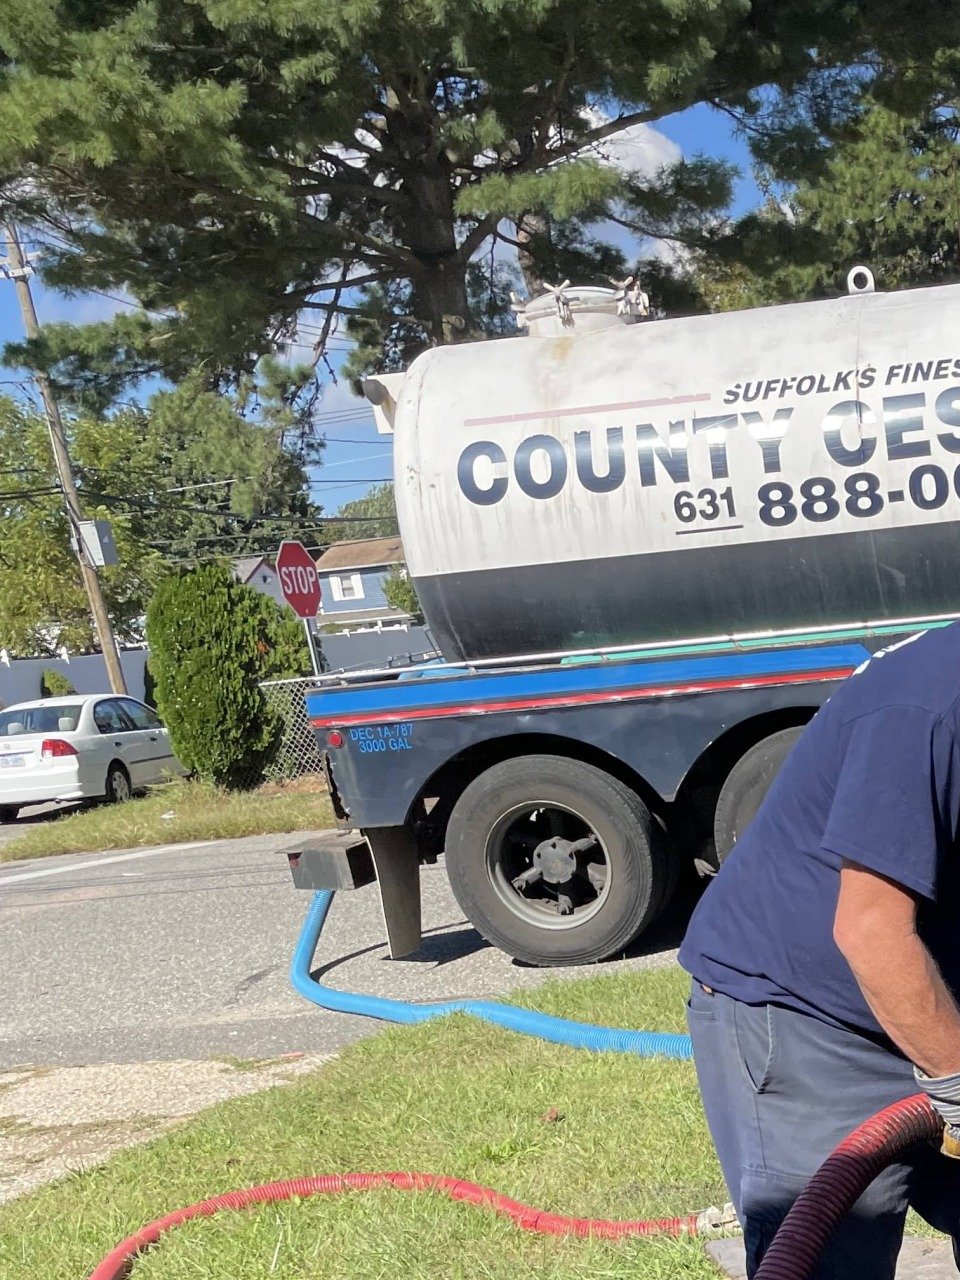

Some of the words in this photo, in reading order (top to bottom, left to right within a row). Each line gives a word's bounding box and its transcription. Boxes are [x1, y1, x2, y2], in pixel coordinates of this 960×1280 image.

[723, 364, 877, 405] SUFFOLK'S
[457, 406, 795, 506] COUNTY
[673, 486, 737, 523] 631
[281, 566, 316, 595] STOP
[350, 727, 374, 741] DEC
[377, 722, 413, 739] 1A-787
[360, 739, 386, 754] 3000
[388, 737, 413, 751] GAL
